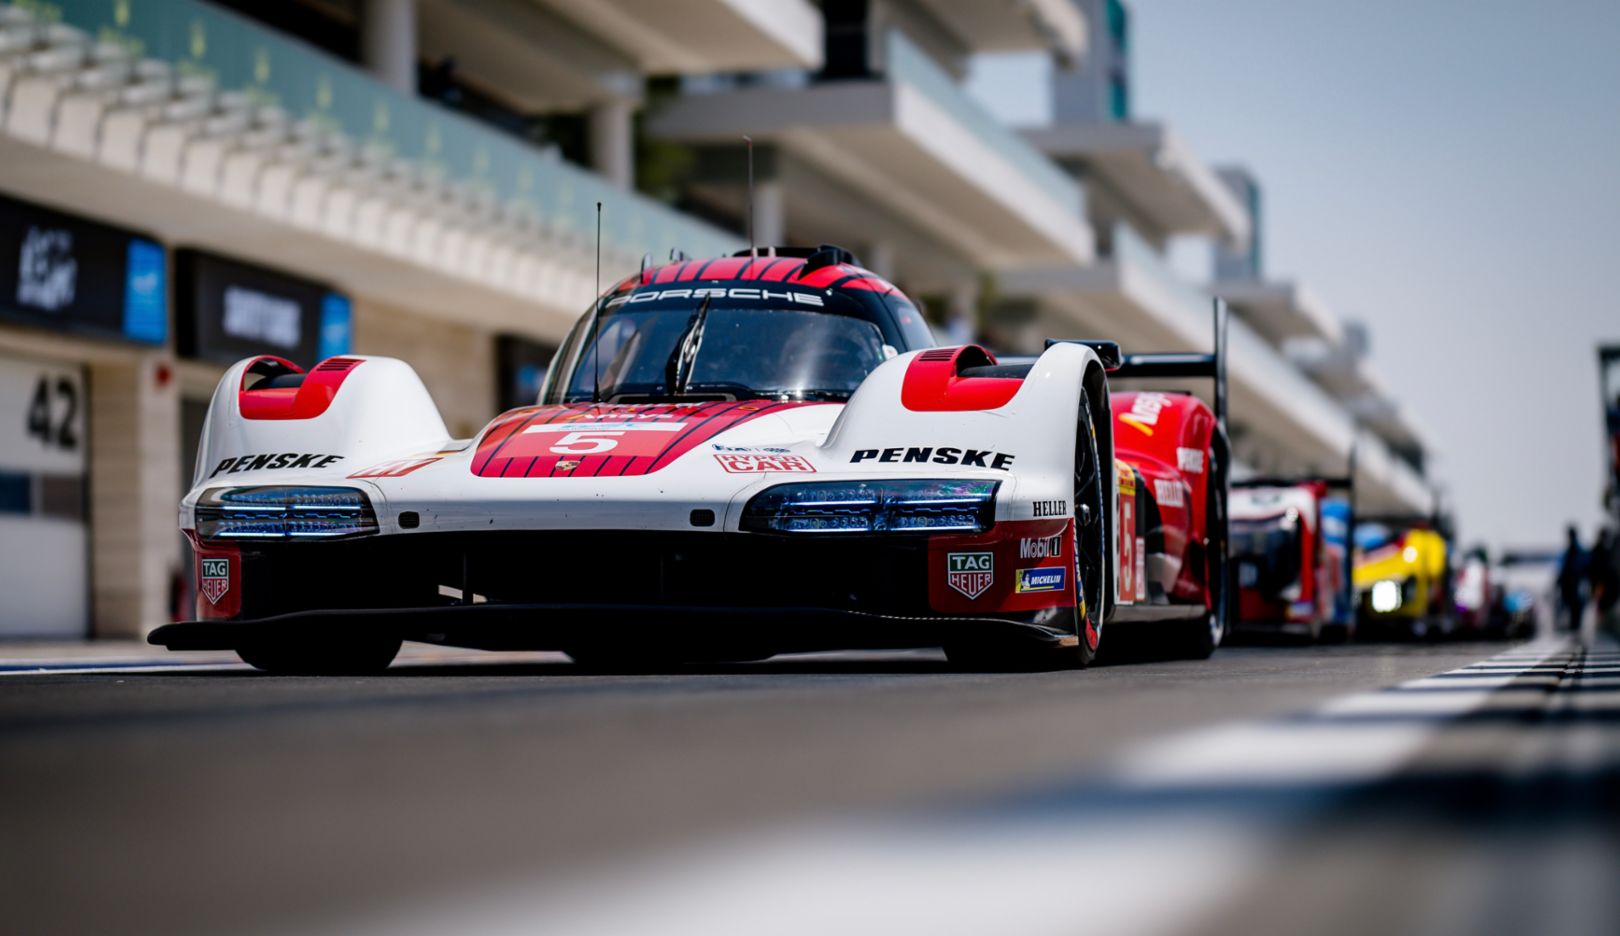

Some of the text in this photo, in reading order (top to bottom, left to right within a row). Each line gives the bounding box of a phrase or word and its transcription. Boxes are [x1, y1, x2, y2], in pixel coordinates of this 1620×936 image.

[604, 288, 824, 308] PORSCHE
[26, 374, 78, 451] 42
[549, 431, 627, 454] 5
[209, 452, 344, 478] PENSKE
[728, 461, 807, 471] CAR
[849, 447, 1015, 471] PENSKE
[1033, 500, 1067, 517] HELLER
[1020, 537, 1050, 559] Mobil
[1123, 502, 1132, 592] 5
[203, 562, 226, 576] TAG
[952, 555, 990, 570] TAG
[951, 574, 991, 596] HEUER
[1030, 575, 1061, 585] MICHELIN
